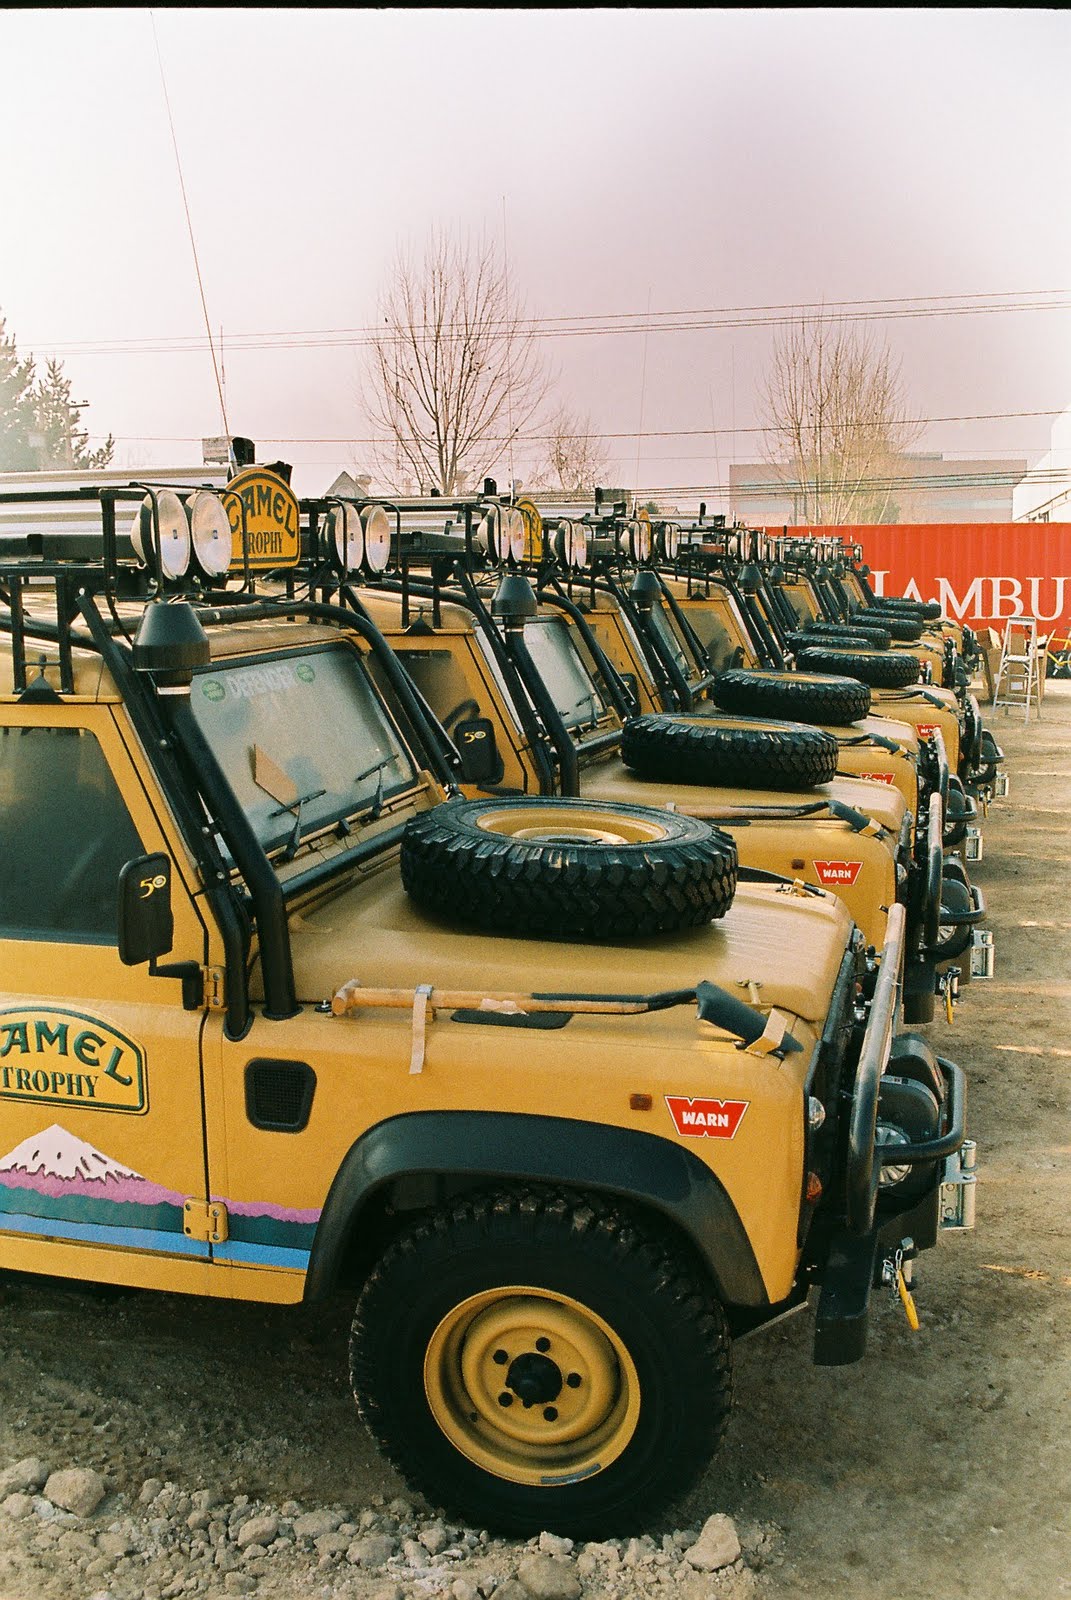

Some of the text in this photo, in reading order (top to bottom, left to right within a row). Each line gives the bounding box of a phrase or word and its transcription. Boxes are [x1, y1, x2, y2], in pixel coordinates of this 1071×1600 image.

[225, 484, 296, 539] CAMEL
[240, 531, 284, 555] ROPHY
[870, 570, 1071, 621] AMBU
[822, 869, 852, 879] WARN
[0, 1020, 133, 1087] AMEL
[0, 1066, 99, 1098] TROPHY
[682, 1111, 729, 1128] WARN
